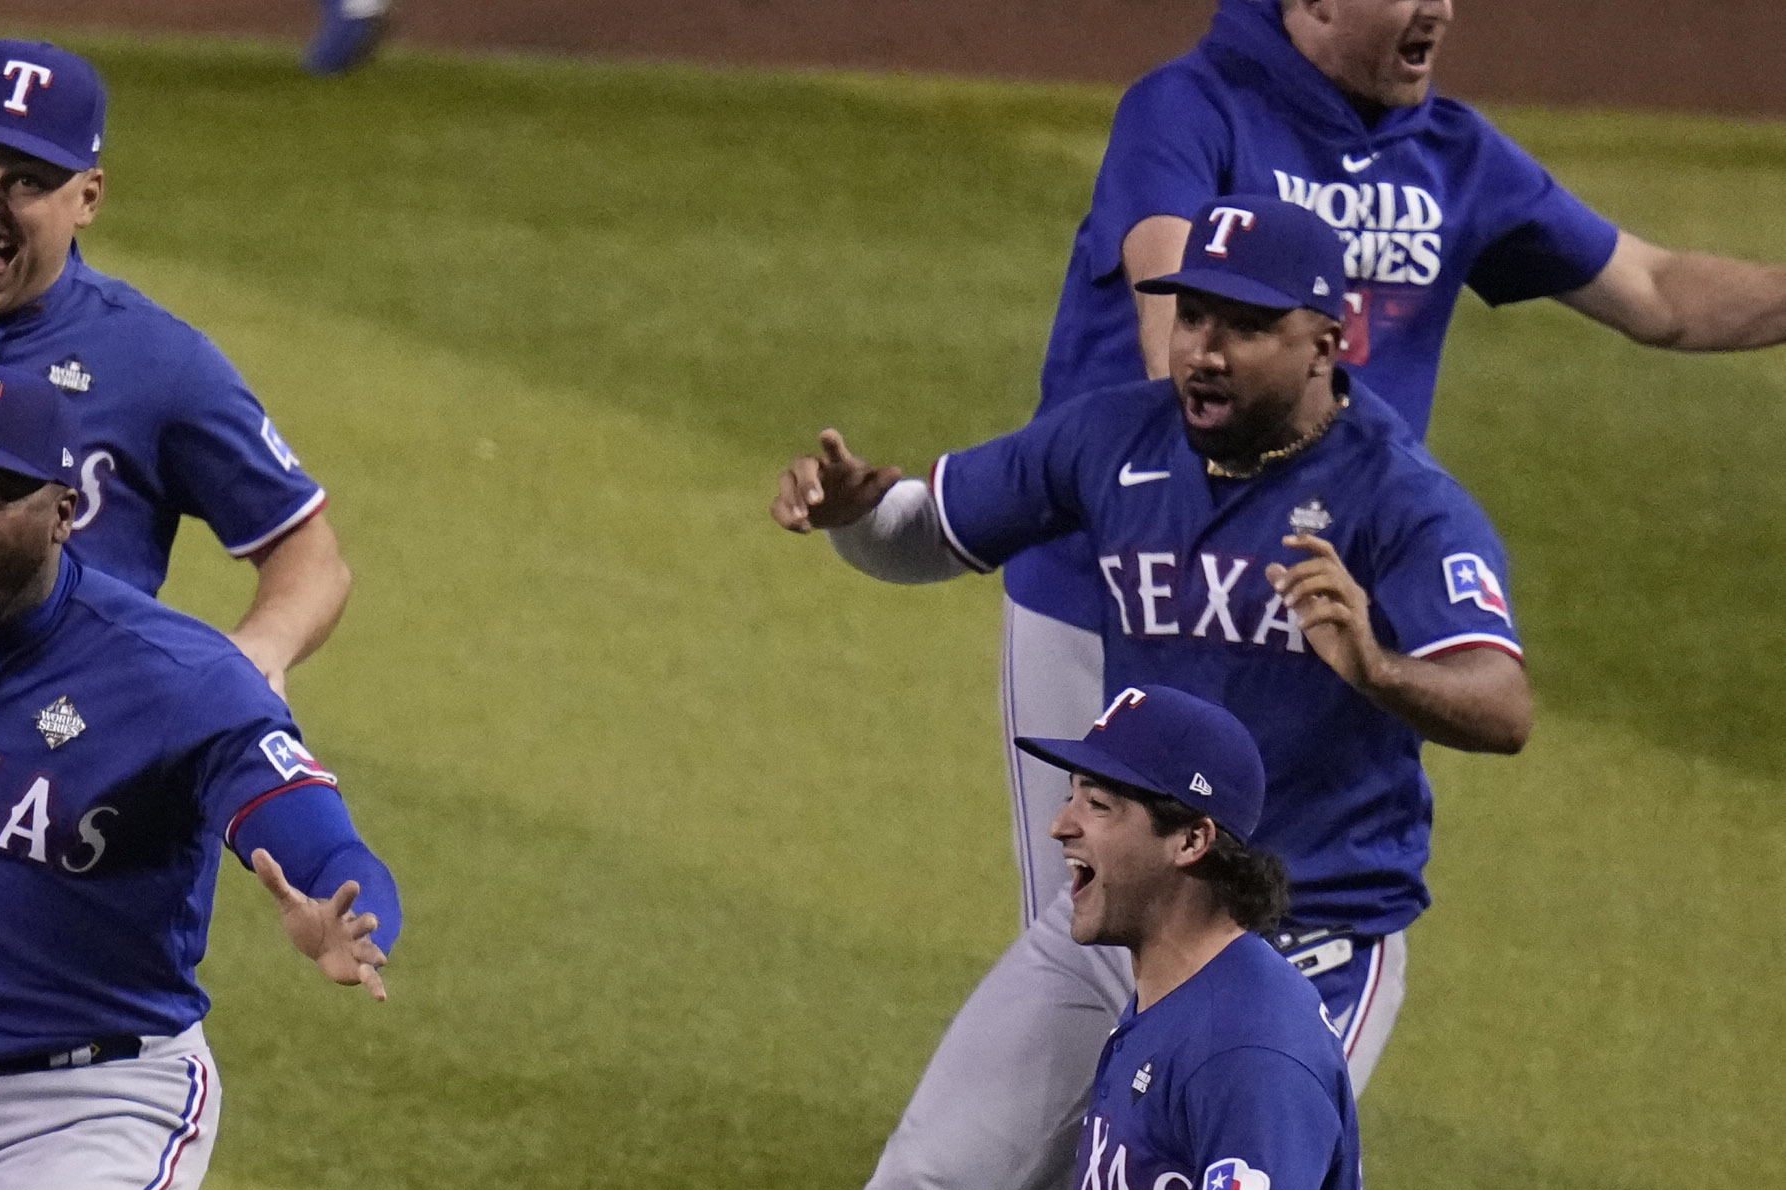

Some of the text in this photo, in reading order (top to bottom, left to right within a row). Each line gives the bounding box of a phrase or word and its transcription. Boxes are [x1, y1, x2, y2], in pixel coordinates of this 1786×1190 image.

[3, 59, 52, 115] T
[1204, 206, 1255, 258] T
[1335, 230, 1443, 286] RIES
[1099, 552, 1305, 654] TEXA
[1094, 686, 1146, 730] T
